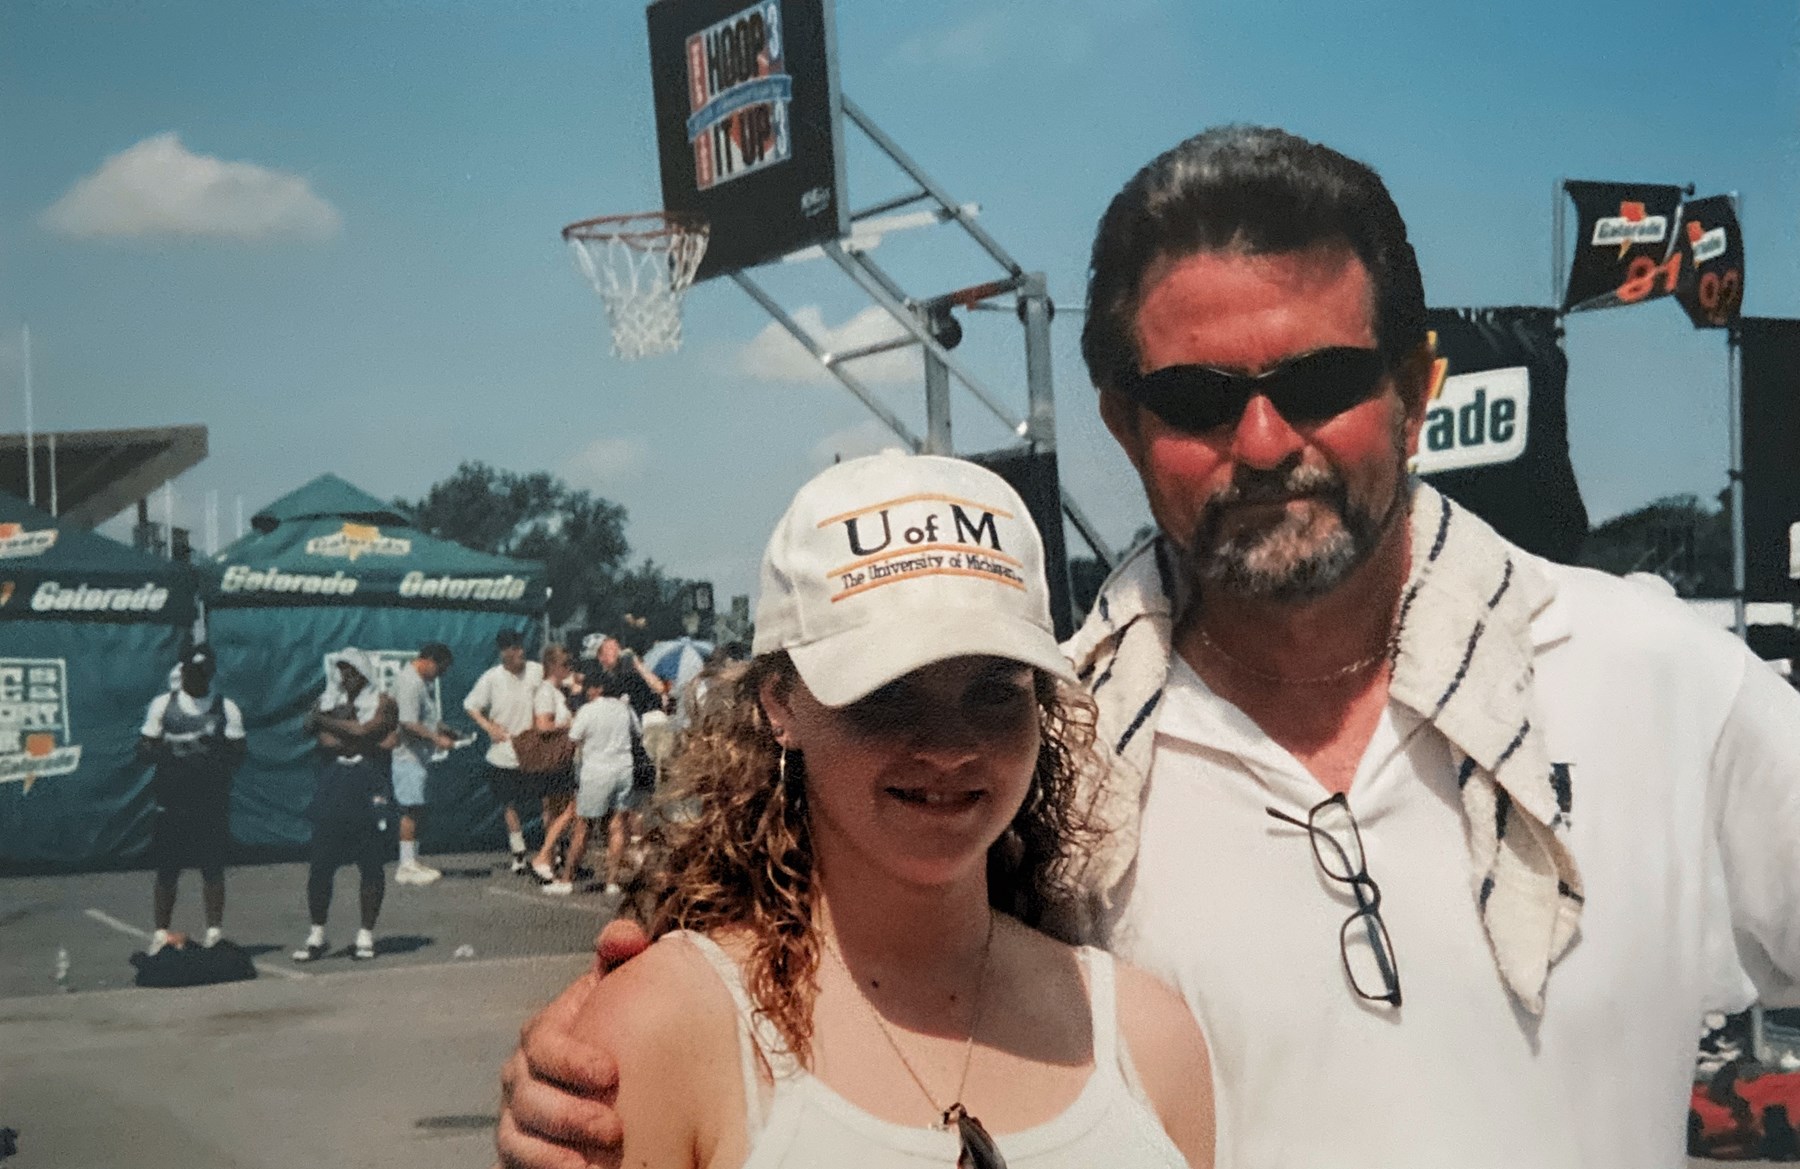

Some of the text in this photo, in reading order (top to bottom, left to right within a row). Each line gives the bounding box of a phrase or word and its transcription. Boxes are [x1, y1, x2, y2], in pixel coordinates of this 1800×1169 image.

[707, 12, 764, 97] HOOP
[713, 117, 734, 177] IT
[740, 103, 771, 166] UP
[1426, 388, 1516, 452] ade
[844, 503, 1003, 556] U of M
[31, 580, 170, 611] Gatorade
[221, 565, 527, 600] Gatorade Gatorade
[841, 572, 866, 590] The
[868, 553, 945, 579] University
[950, 553, 962, 568] of
